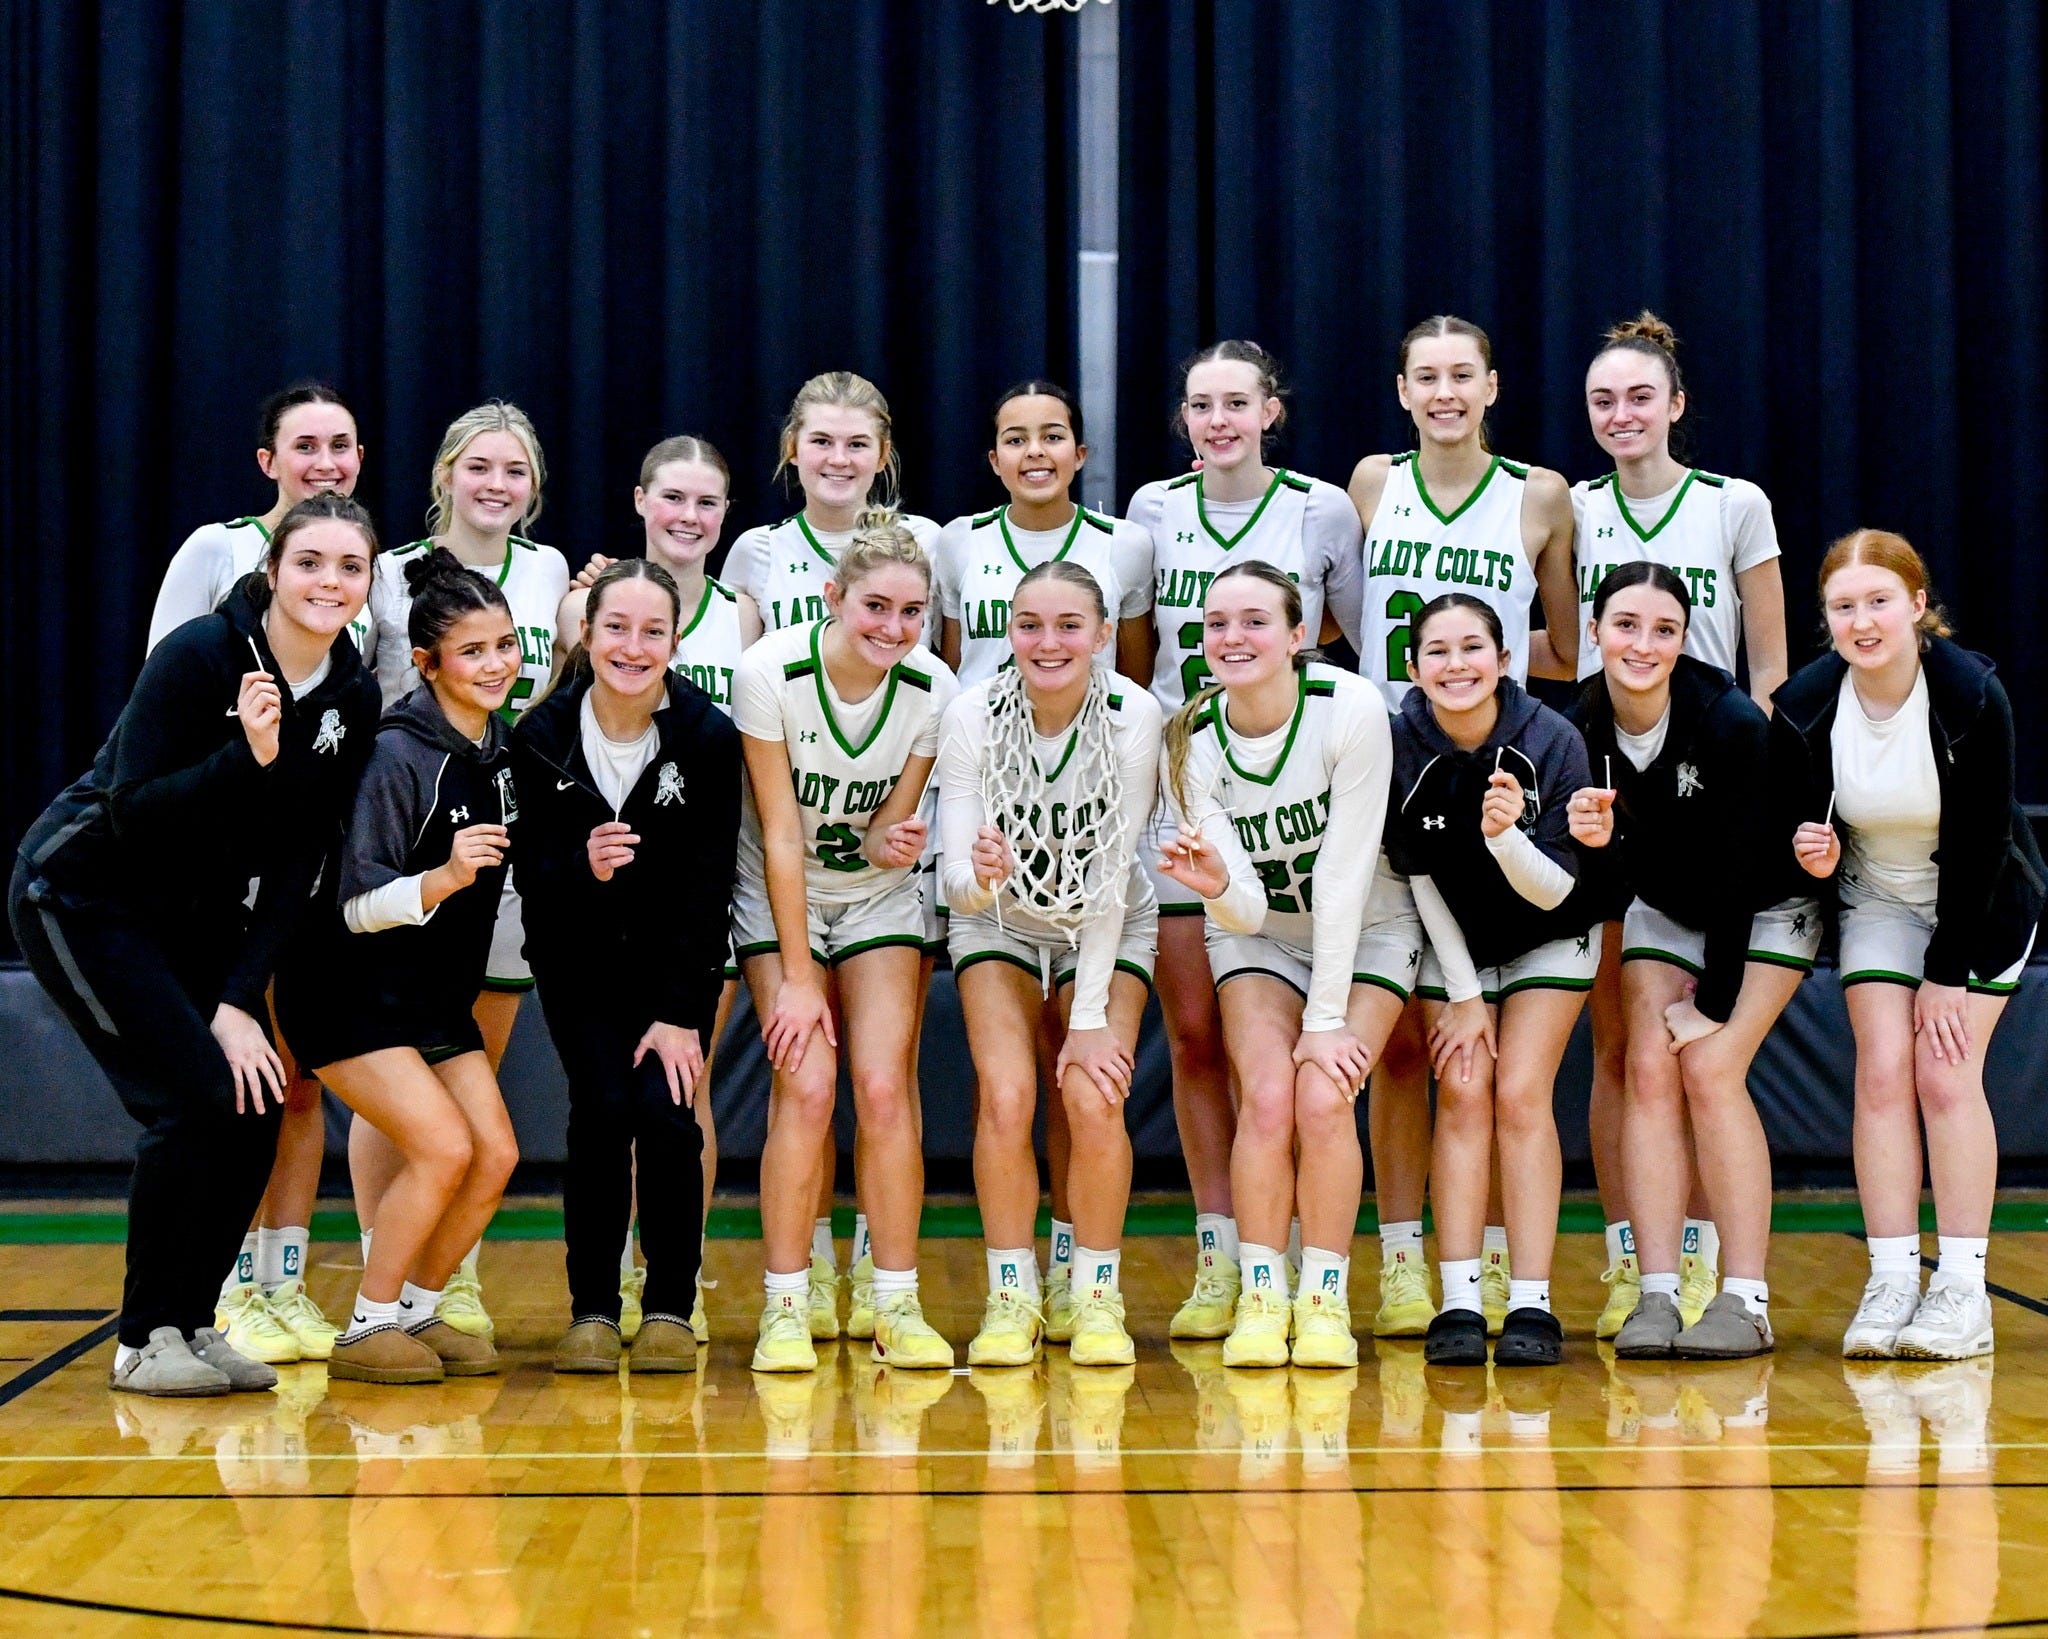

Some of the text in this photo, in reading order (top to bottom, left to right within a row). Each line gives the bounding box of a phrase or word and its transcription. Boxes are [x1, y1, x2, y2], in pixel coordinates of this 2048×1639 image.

[1369, 539, 1515, 592] LADY COLTS
[1157, 568, 1216, 608] LADY
[772, 595, 830, 629] LAD
[965, 599, 1014, 639] LAD
[516, 626, 551, 667] LTS
[815, 822, 870, 872] 2
[1228, 811, 1270, 853] DY
